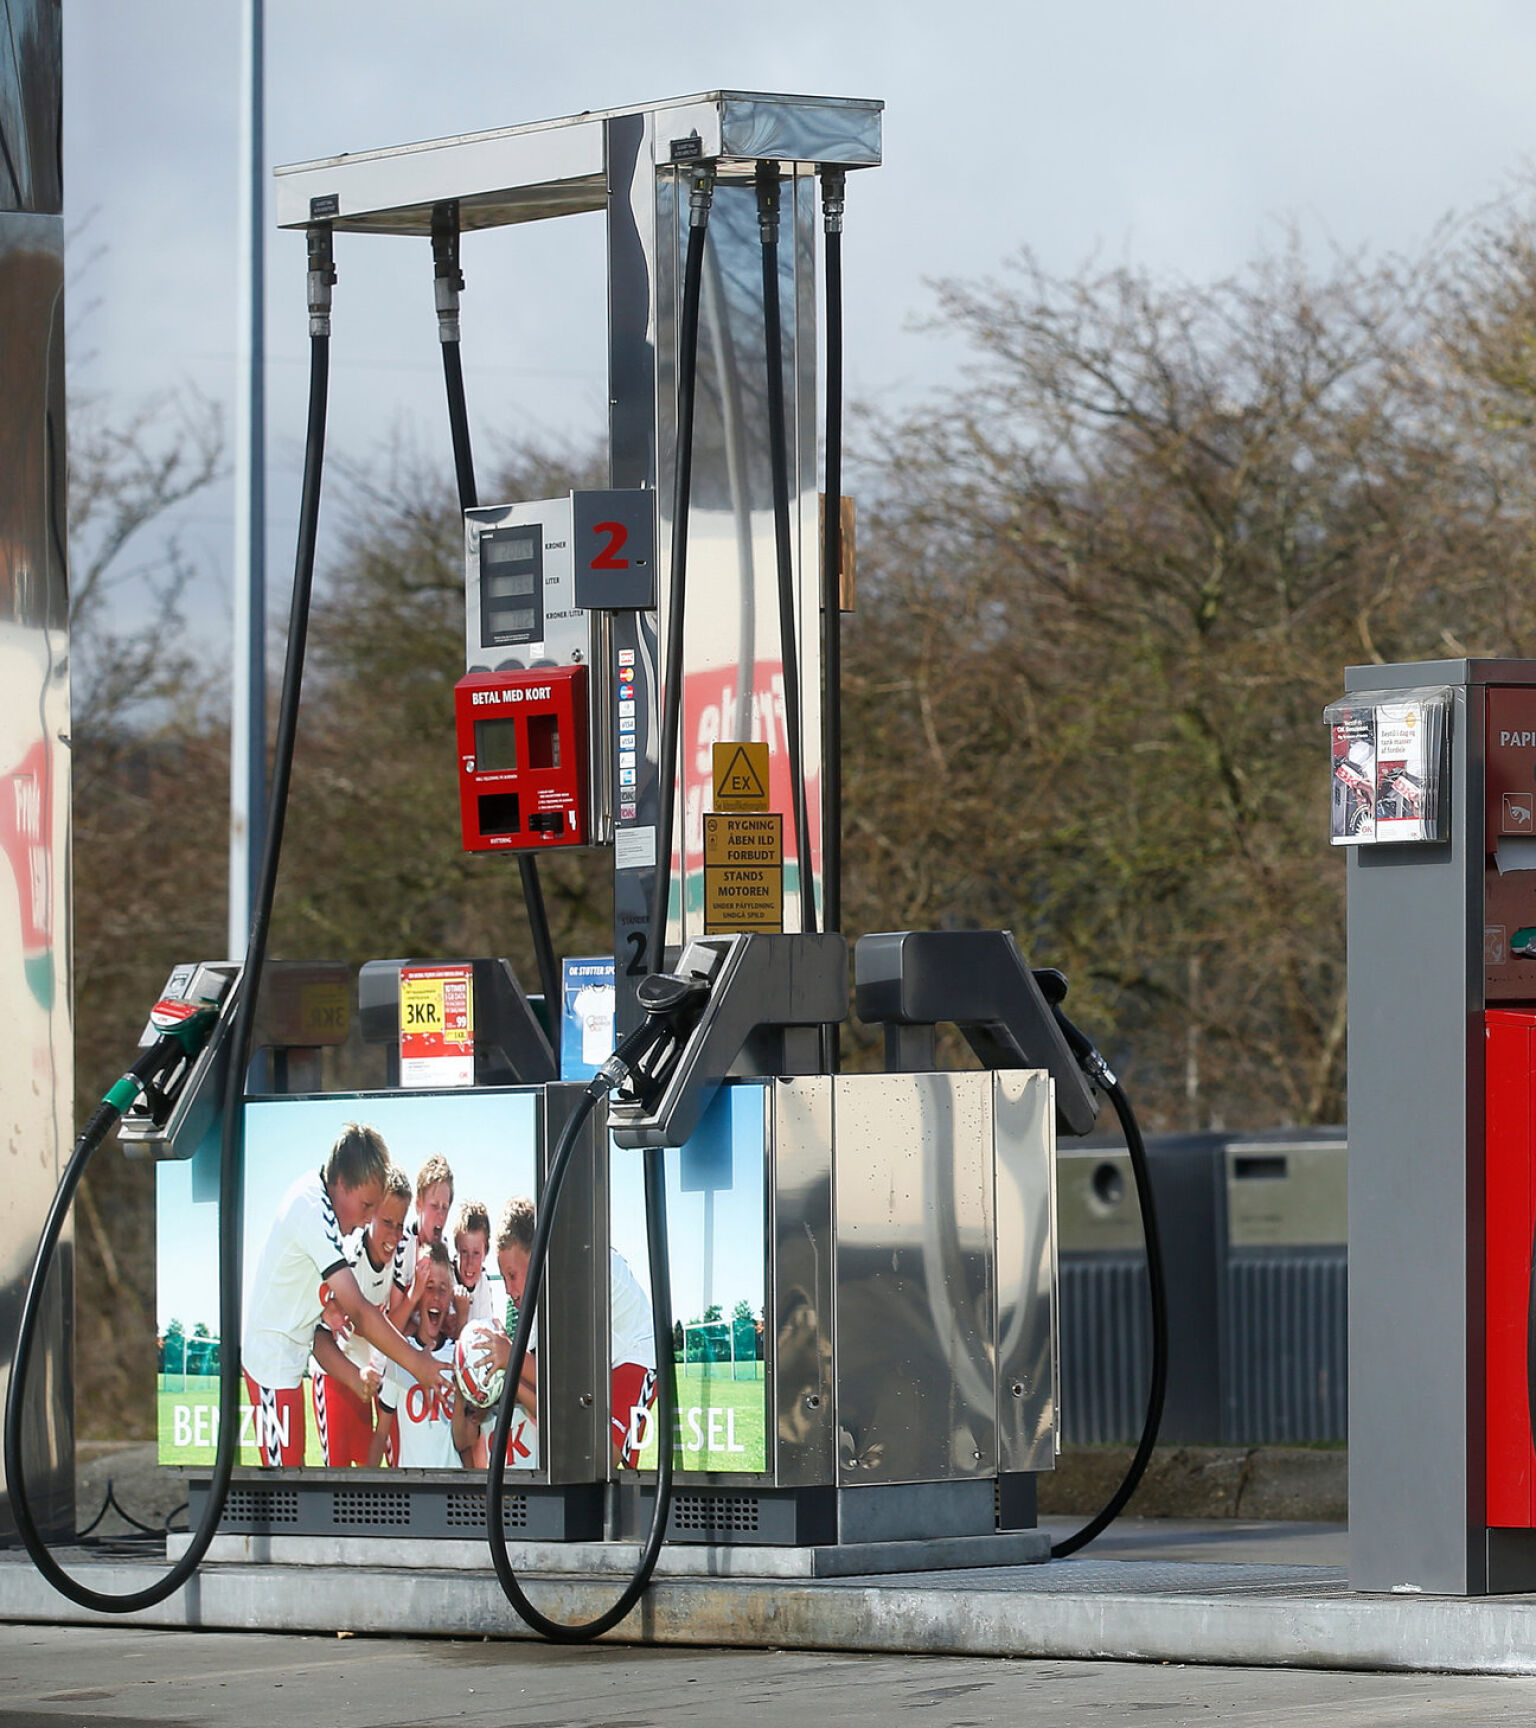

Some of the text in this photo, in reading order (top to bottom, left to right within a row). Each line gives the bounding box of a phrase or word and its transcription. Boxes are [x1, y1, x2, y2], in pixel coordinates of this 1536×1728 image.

[545, 542, 566, 550] KRONER
[590, 521, 630, 570] 2
[545, 576, 560, 584] LITER
[472, 686, 551, 705] BETAL MED KORT
[732, 776, 751, 790] EX
[728, 820, 774, 830] RYGNING
[728, 833, 774, 845] ÅBEN ILD
[728, 850, 775, 860] FORBUDT
[723, 871, 764, 881] STANDS
[718, 886, 769, 896] MOTOREN
[626, 932, 648, 976] 2
[407, 1004, 440, 1024] 3KR.
[406, 1384, 455, 1423] OK
[630, 1406, 744, 1452] DESEL
